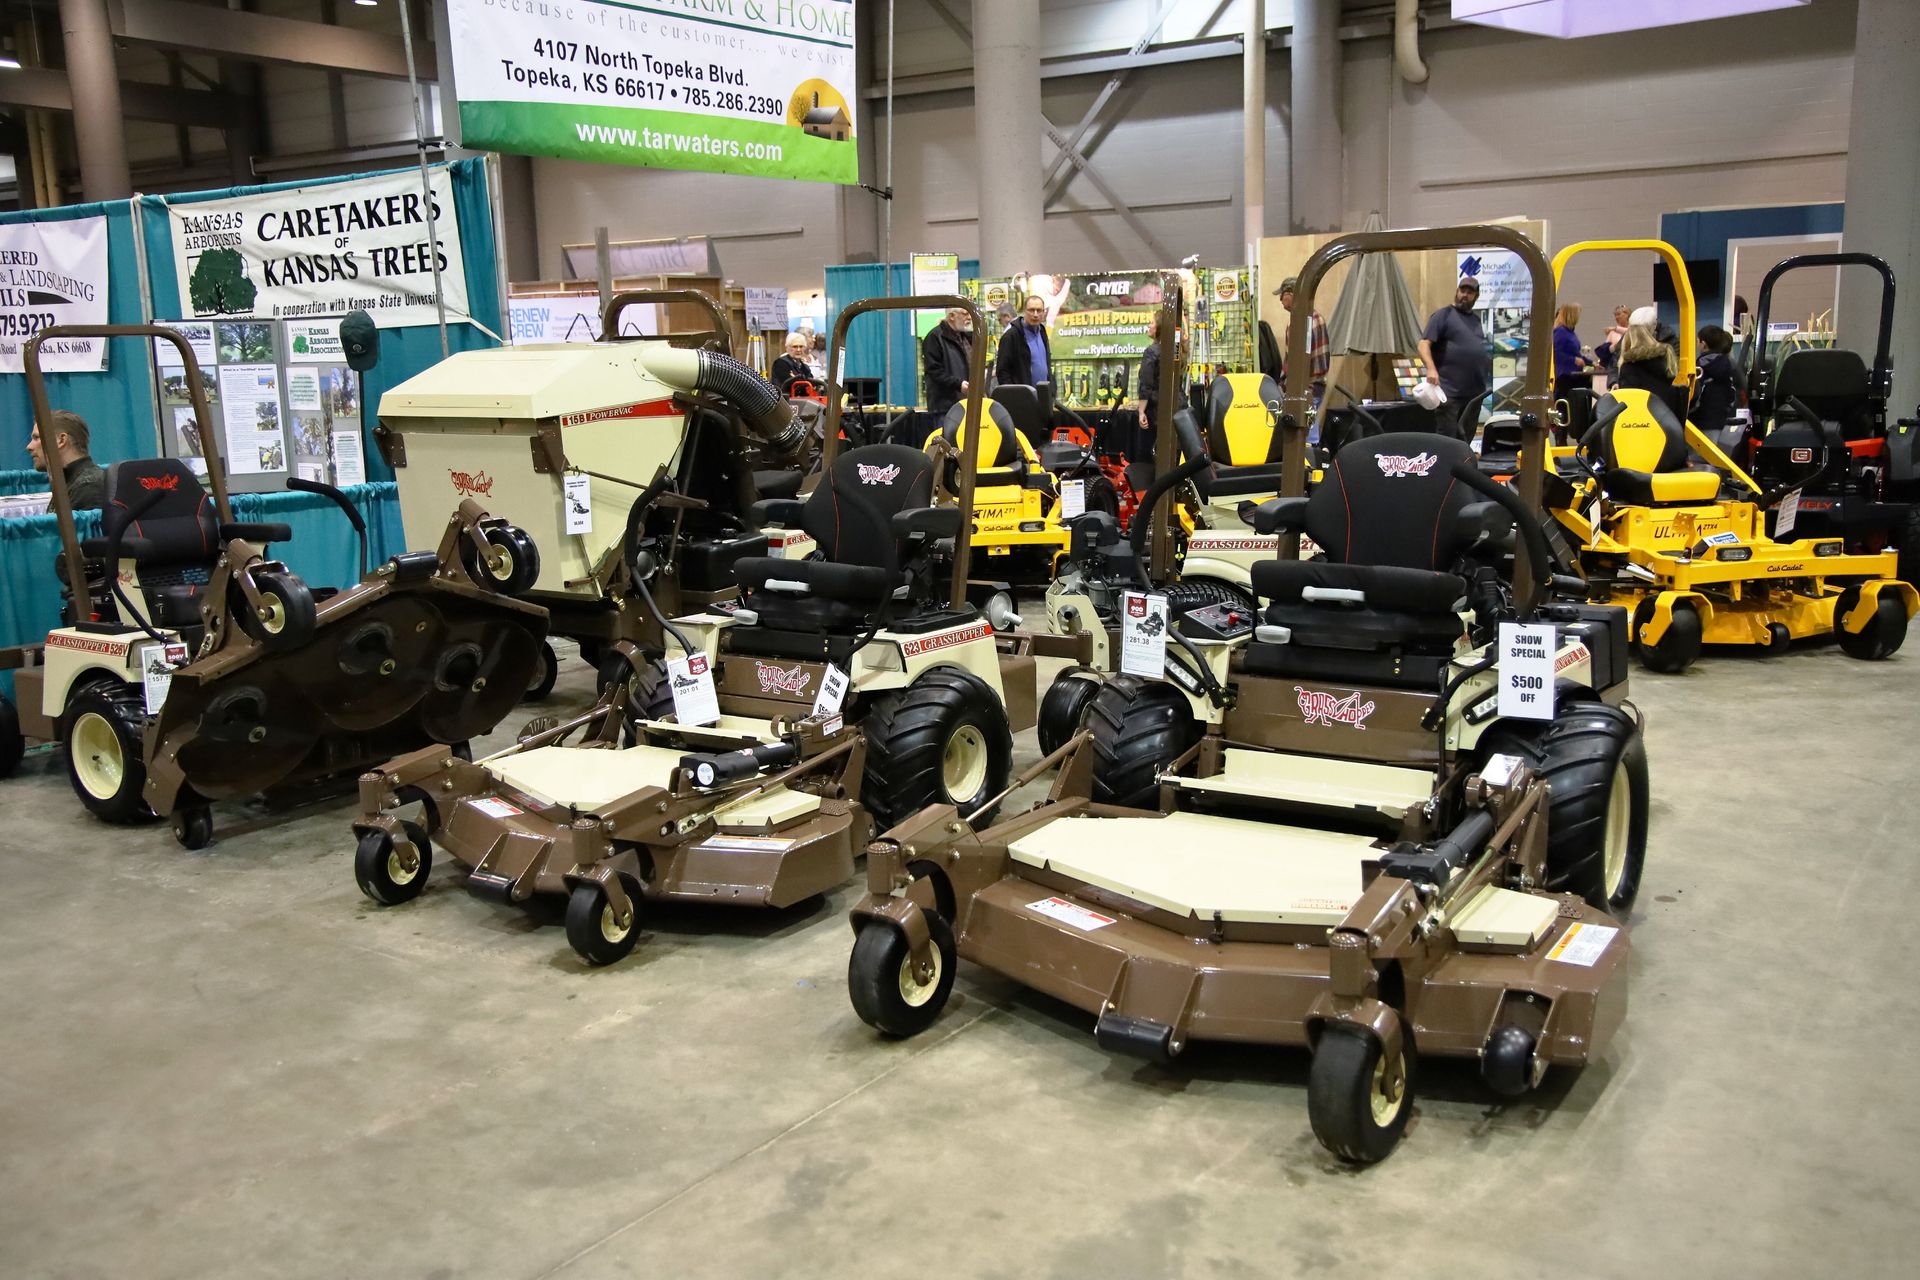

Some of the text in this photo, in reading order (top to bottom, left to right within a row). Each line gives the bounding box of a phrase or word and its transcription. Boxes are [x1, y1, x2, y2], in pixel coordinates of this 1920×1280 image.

[777, 0, 854, 37] HOME
[587, 9, 607, 27] of
[619, 14, 648, 33] the
[778, 44, 798, 58] we
[534, 38, 749, 87] 4107 North Topeka Blvd.
[501, 59, 783, 116] Topeka, KS 66617 785.286.2390
[575, 123, 783, 161] www.tarwaters.com
[257, 189, 442, 242] CARETAKERS
[185, 232, 242, 249] ARBORISTS
[334, 237, 350, 249] OF
[263, 240, 448, 287] KANSAS TREES
[9, 269, 95, 302] LANDSCAPING
[1098, 281, 1131, 296] RYKER
[273, 304, 281, 316] In
[283, 301, 327, 318] cooperation
[330, 298, 348, 312] with
[349, 297, 376, 310] Kansas
[379, 293, 401, 308] State
[1063, 312, 1088, 327] FEEL
[1089, 311, 1112, 326] THE
[1058, 327, 1083, 338] Quality
[1083, 326, 1100, 336] Tools
[1100, 326, 1117, 335] With
[57, 341, 70, 354] KS
[71, 341, 92, 354] 66618
[569, 406, 634, 425] 15B POWERVAC
[1192, 540, 1279, 549] GRASSHOPPE
[50, 635, 108, 652] GRASSHOPPER
[903, 626, 986, 656] 623 GRASSHOPPER
[1515, 634, 1542, 645] SHOW
[1511, 648, 1546, 659] SPECIAL
[828, 674, 842, 689] SHOW
[1511, 674, 1543, 689] $500
[824, 683, 839, 700] SPECIAL
[1520, 693, 1536, 703] OFF
[1294, 686, 1375, 730] GRASSHOPPER
